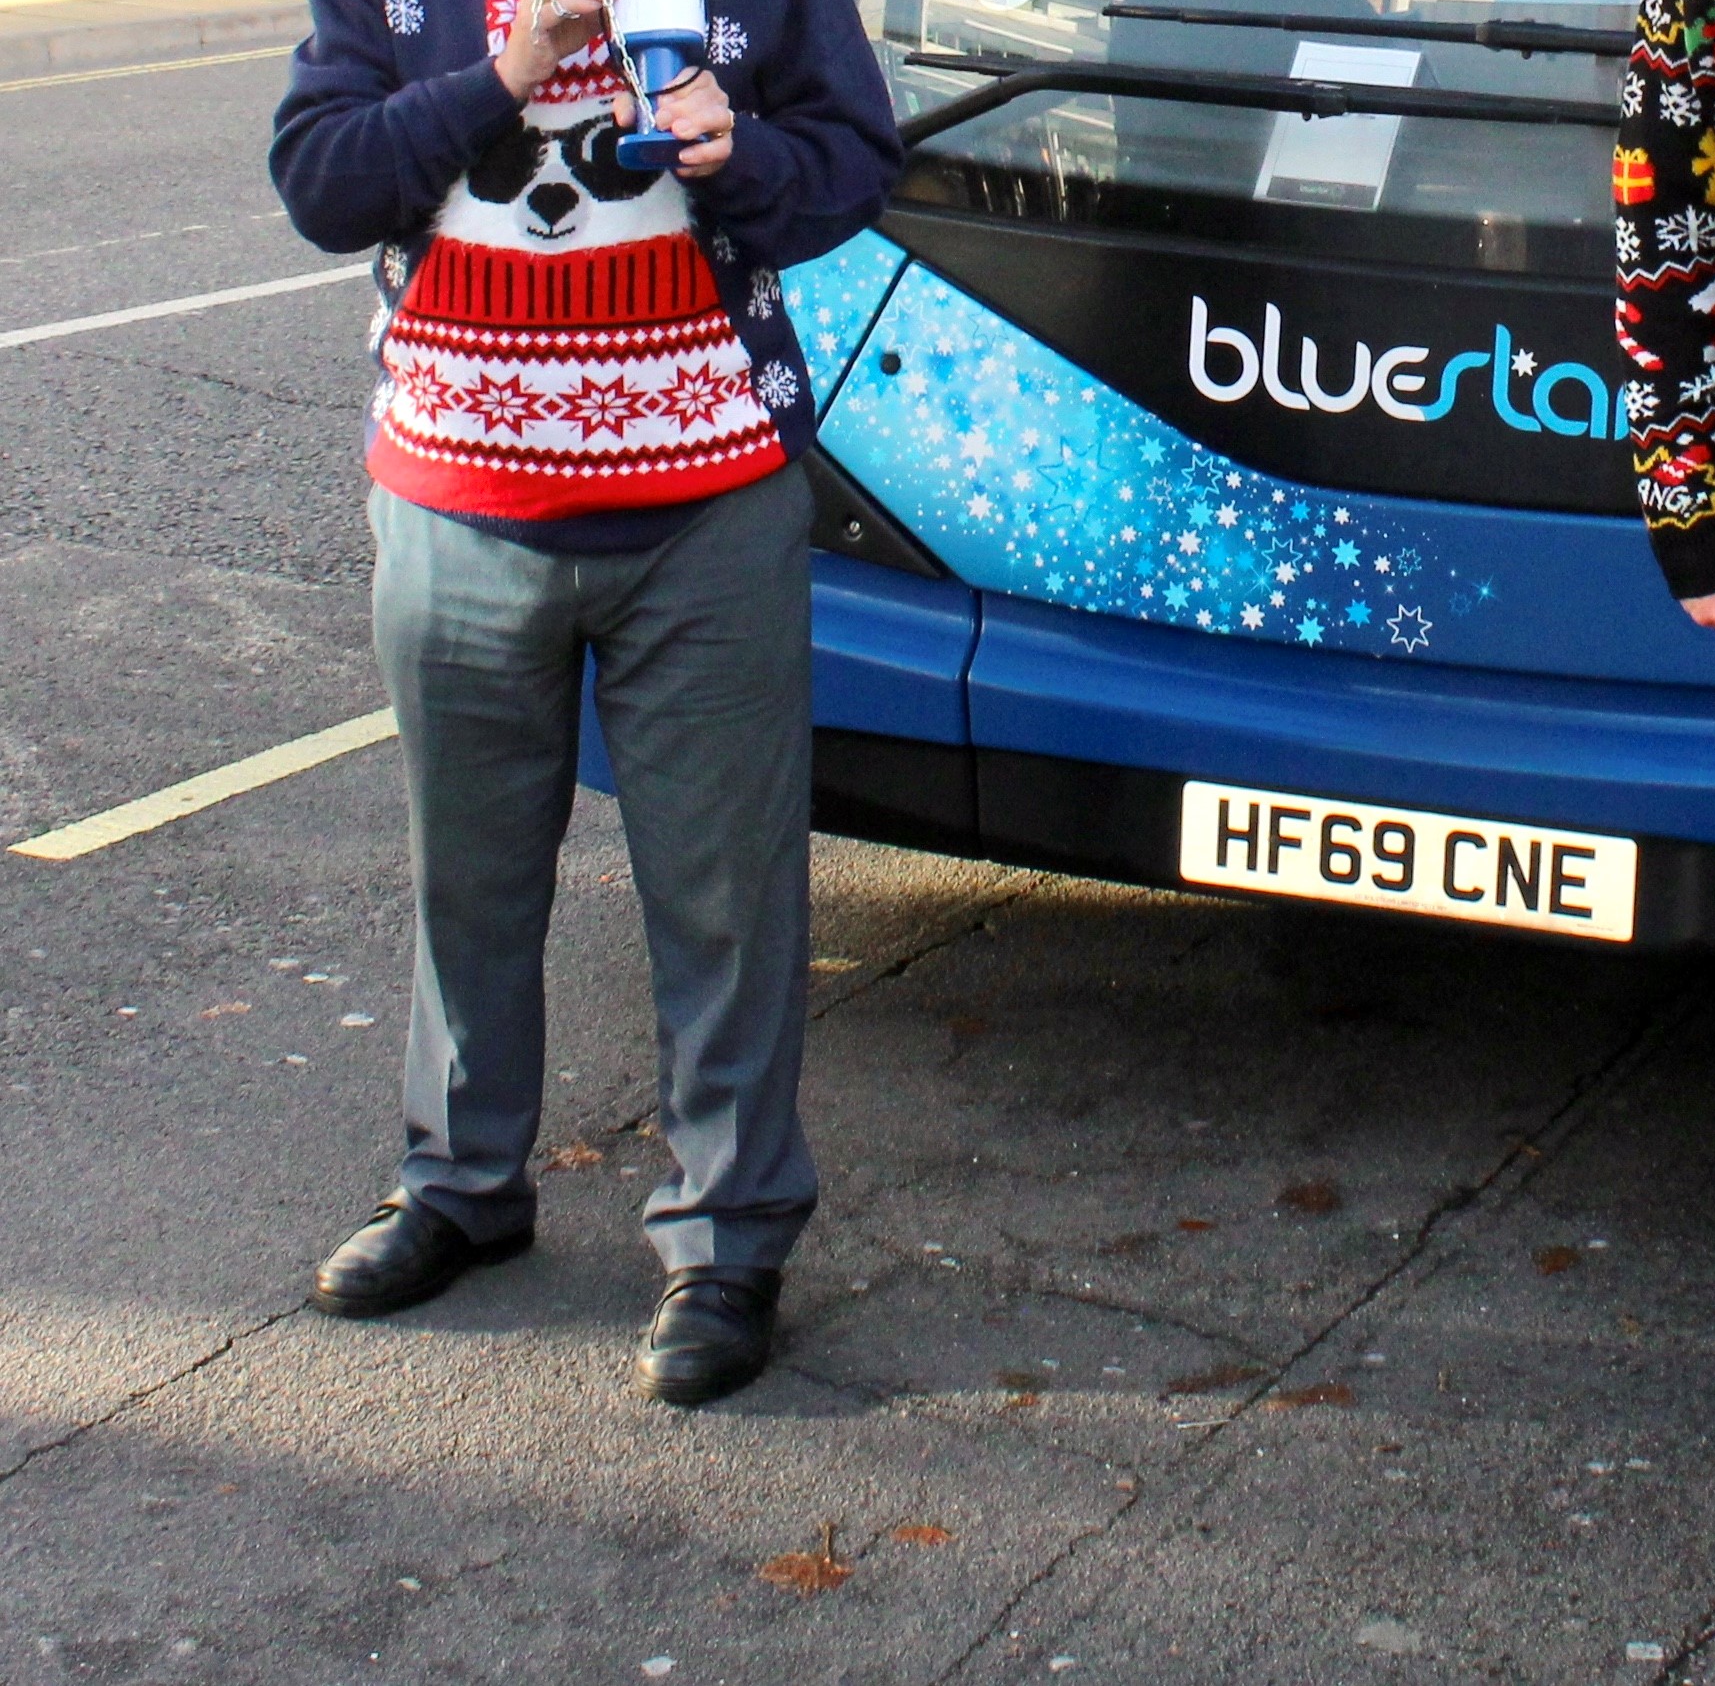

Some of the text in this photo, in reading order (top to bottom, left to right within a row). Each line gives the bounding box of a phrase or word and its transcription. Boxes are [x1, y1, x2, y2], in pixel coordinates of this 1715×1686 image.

[1637, 478, 1708, 519] ANG!
[1216, 798, 1597, 920] HF69 CNE
